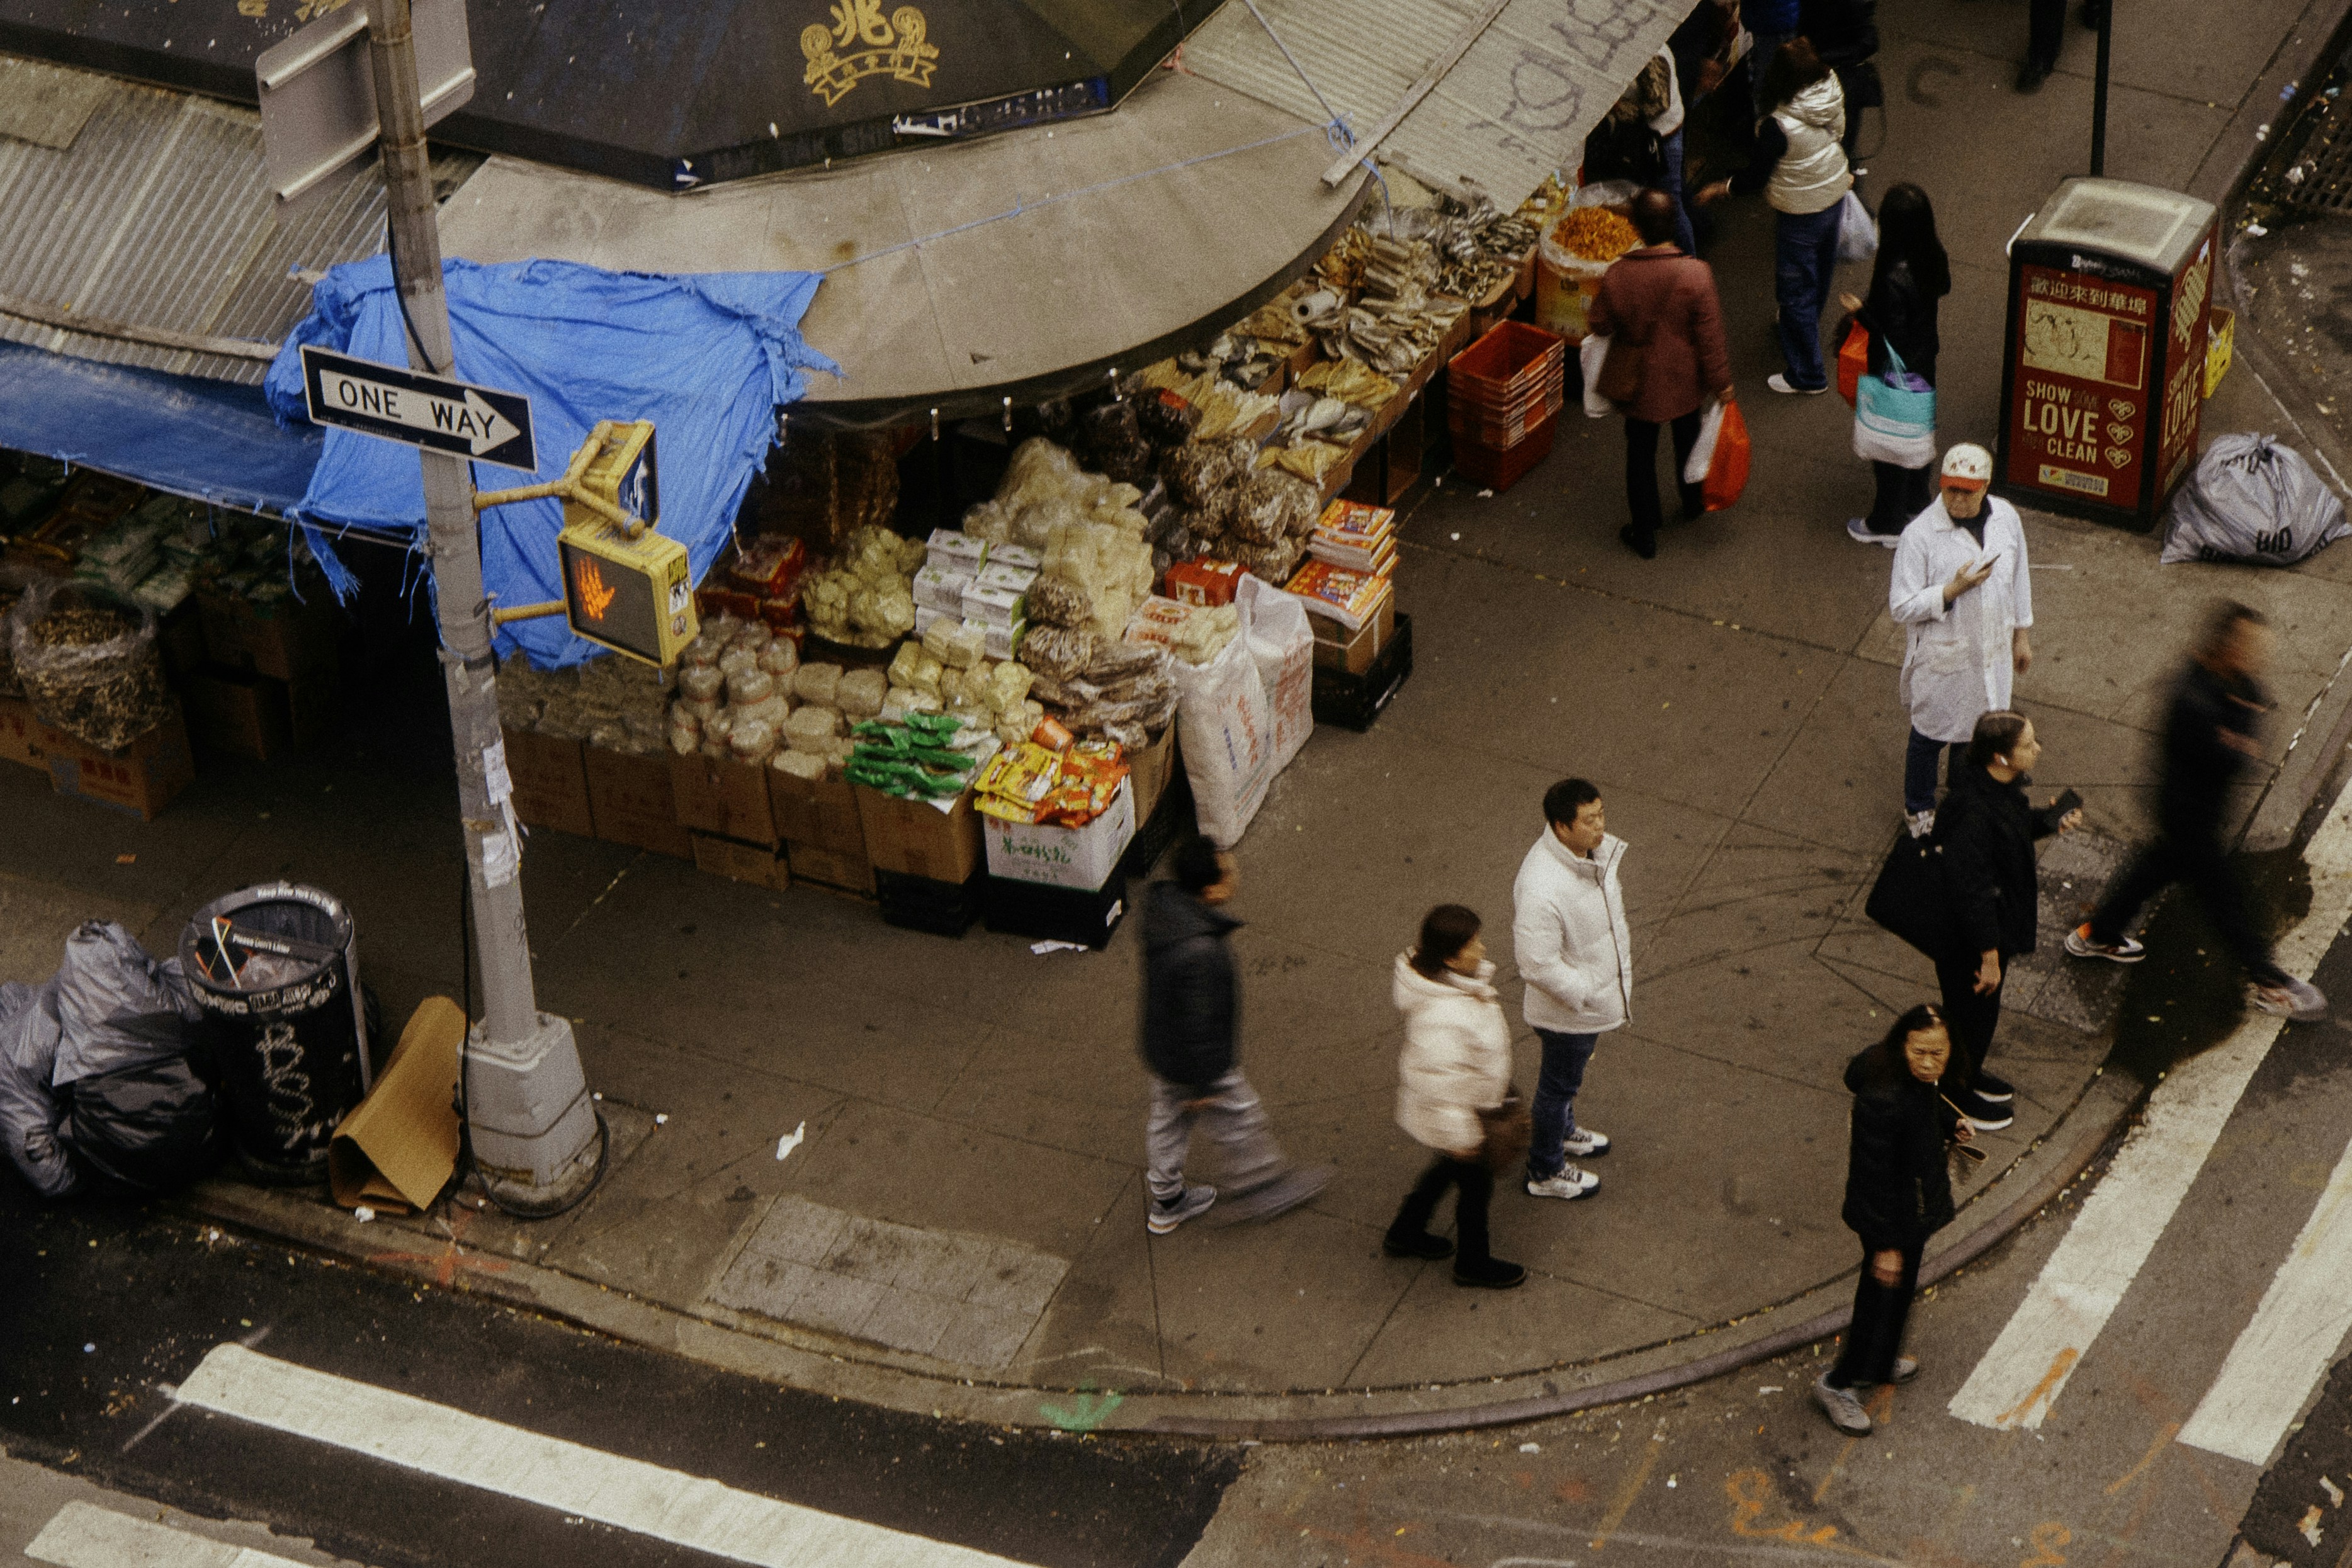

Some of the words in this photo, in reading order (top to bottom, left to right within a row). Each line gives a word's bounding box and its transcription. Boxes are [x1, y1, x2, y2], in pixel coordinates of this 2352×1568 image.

[2030, 276, 2147, 315] 歡迎來到華埠
[339, 380, 402, 419] ONE
[431, 401, 495, 439] WAY
[2026, 379, 2071, 403] SHOW
[2164, 361, 2202, 449] LOVE
[2023, 399, 2100, 444] LOVE
[2047, 437, 2098, 465] CLEAN
